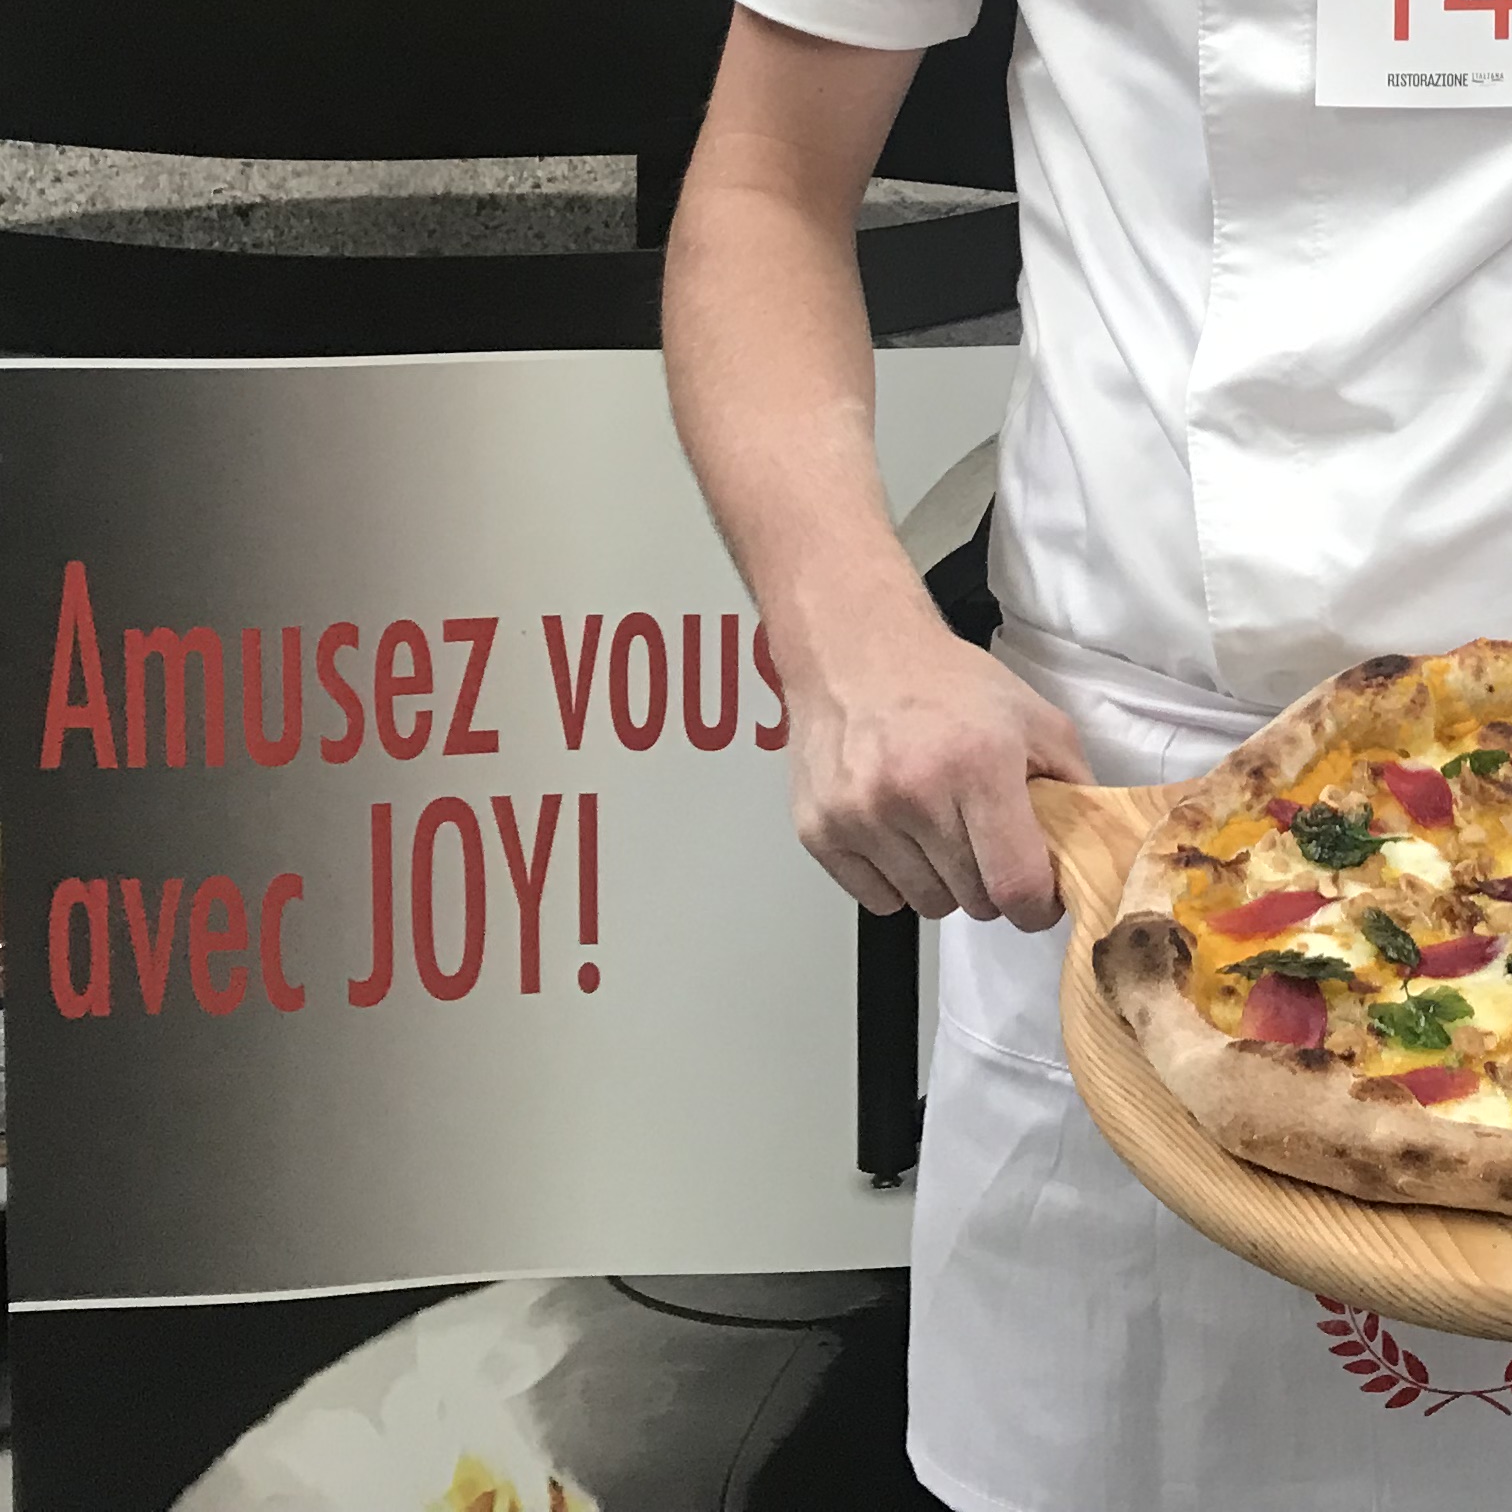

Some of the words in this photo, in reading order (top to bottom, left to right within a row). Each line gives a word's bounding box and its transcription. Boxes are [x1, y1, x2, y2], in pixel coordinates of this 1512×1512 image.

[1387, 73, 1468, 88] RISTORAZIONE
[40, 560, 500, 769] Amusez
[543, 611, 789, 752] vous
[48, 873, 306, 1019] avec
[348, 792, 602, 1009] JOY!
